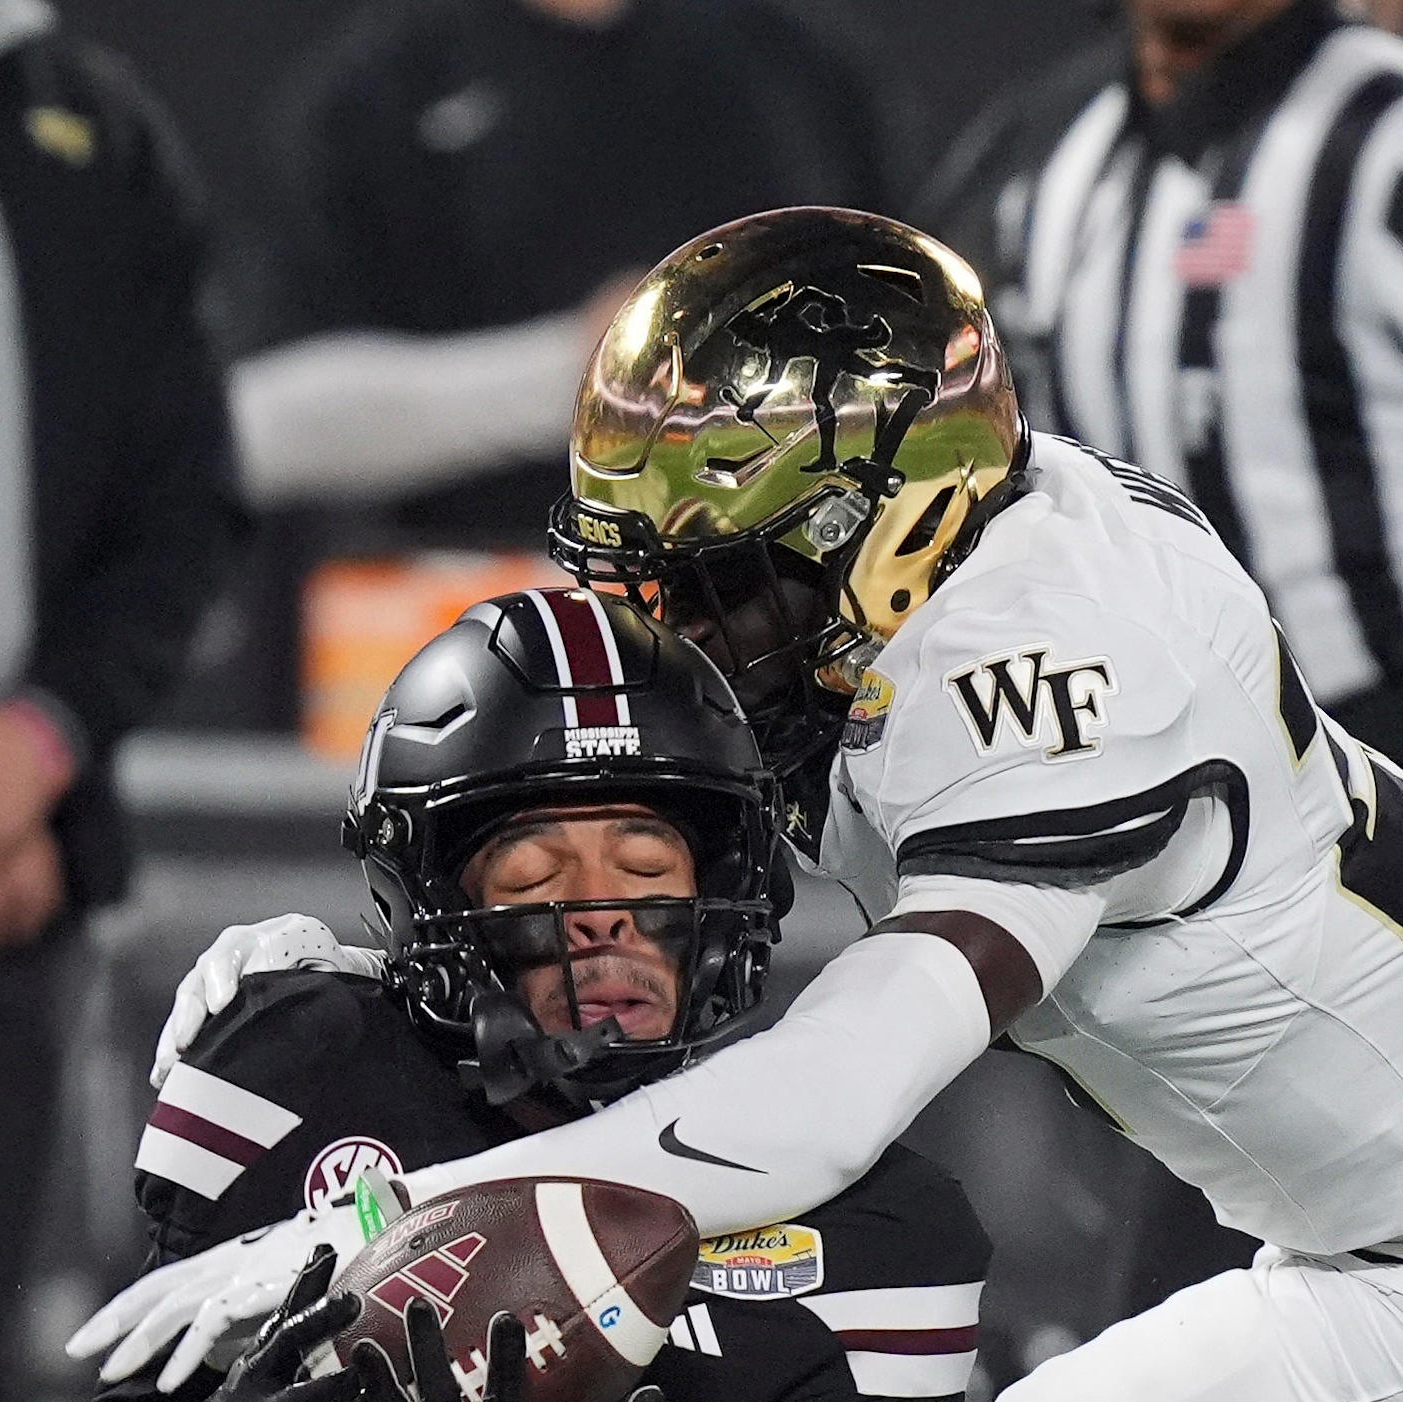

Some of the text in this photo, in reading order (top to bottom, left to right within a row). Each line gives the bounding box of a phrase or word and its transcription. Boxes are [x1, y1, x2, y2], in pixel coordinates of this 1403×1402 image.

[948, 650, 1109, 758] WF
[565, 739, 641, 758] STATE
[705, 1230, 791, 1254] Duke's
[711, 1268, 792, 1295] BOWL
